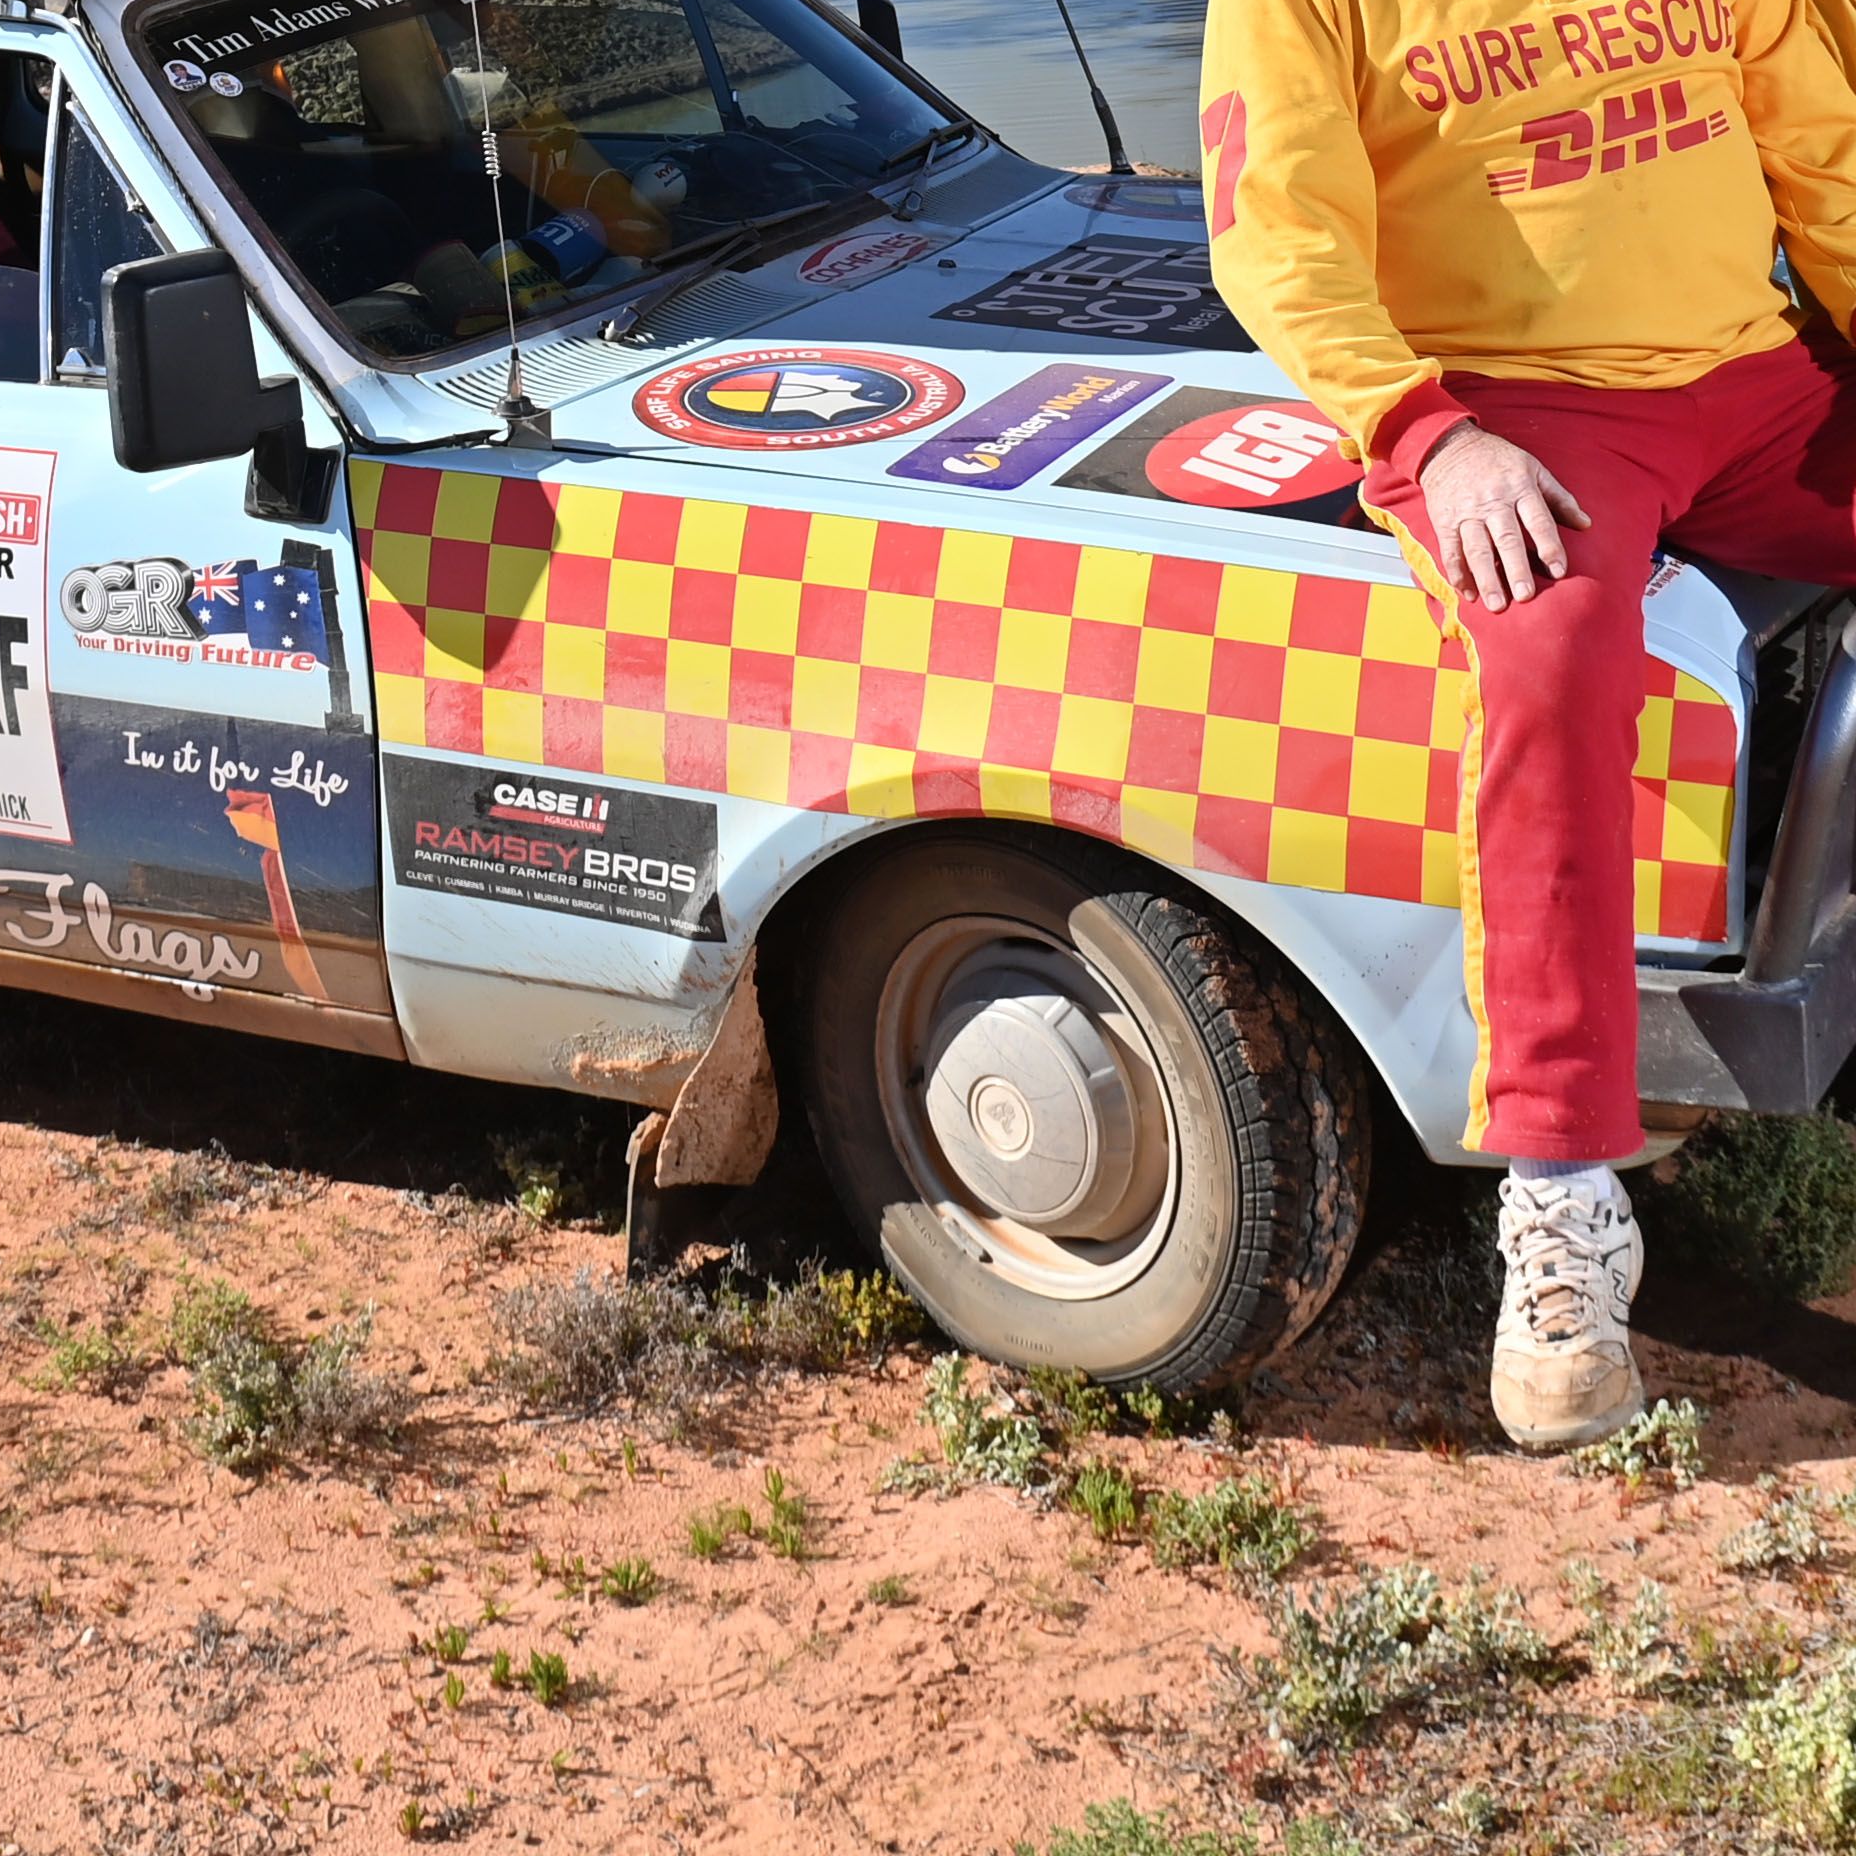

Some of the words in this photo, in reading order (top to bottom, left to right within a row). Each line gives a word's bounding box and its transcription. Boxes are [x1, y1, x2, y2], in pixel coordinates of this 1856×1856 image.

[173, 30, 251, 67] Tim
[1405, 22, 1544, 113] SURF
[1519, 80, 1711, 192] DHL
[804, 233, 923, 283] COCHRANES
[975, 245, 1178, 316] STEEL
[656, 370, 695, 395] LIFE
[695, 350, 823, 372] SAVING
[646, 396, 693, 432] SURF
[766, 423, 896, 445] SOUTH
[899, 364, 949, 426] AUSTRALIA
[1097, 379, 1142, 405] Marion
[1180, 409, 1339, 498] IGA
[60, 557, 209, 642] OGR
[75, 634, 108, 649] Your
[114, 637, 190, 663] Driving
[201, 644, 316, 671] Future
[122, 731, 164, 769] In
[173, 741, 200, 773] it
[209, 746, 259, 792] for
[271, 750, 348, 807] Life
[493, 783, 578, 817] CASE
[544, 815, 604, 833] AGRICULTURE
[406, 869, 434, 883] CLEVE
[495, 884, 524, 898] KIMBA
[534, 891, 570, 907] MURRAY
[571, 899, 605, 913] BRIDGE
[616, 905, 661, 923] RIVERTON
[414, 849, 505, 874] PARTNERING
[509, 865, 578, 886] FARMERS
[582, 878, 628, 895] SINCE
[632, 887, 667, 902] 1950
